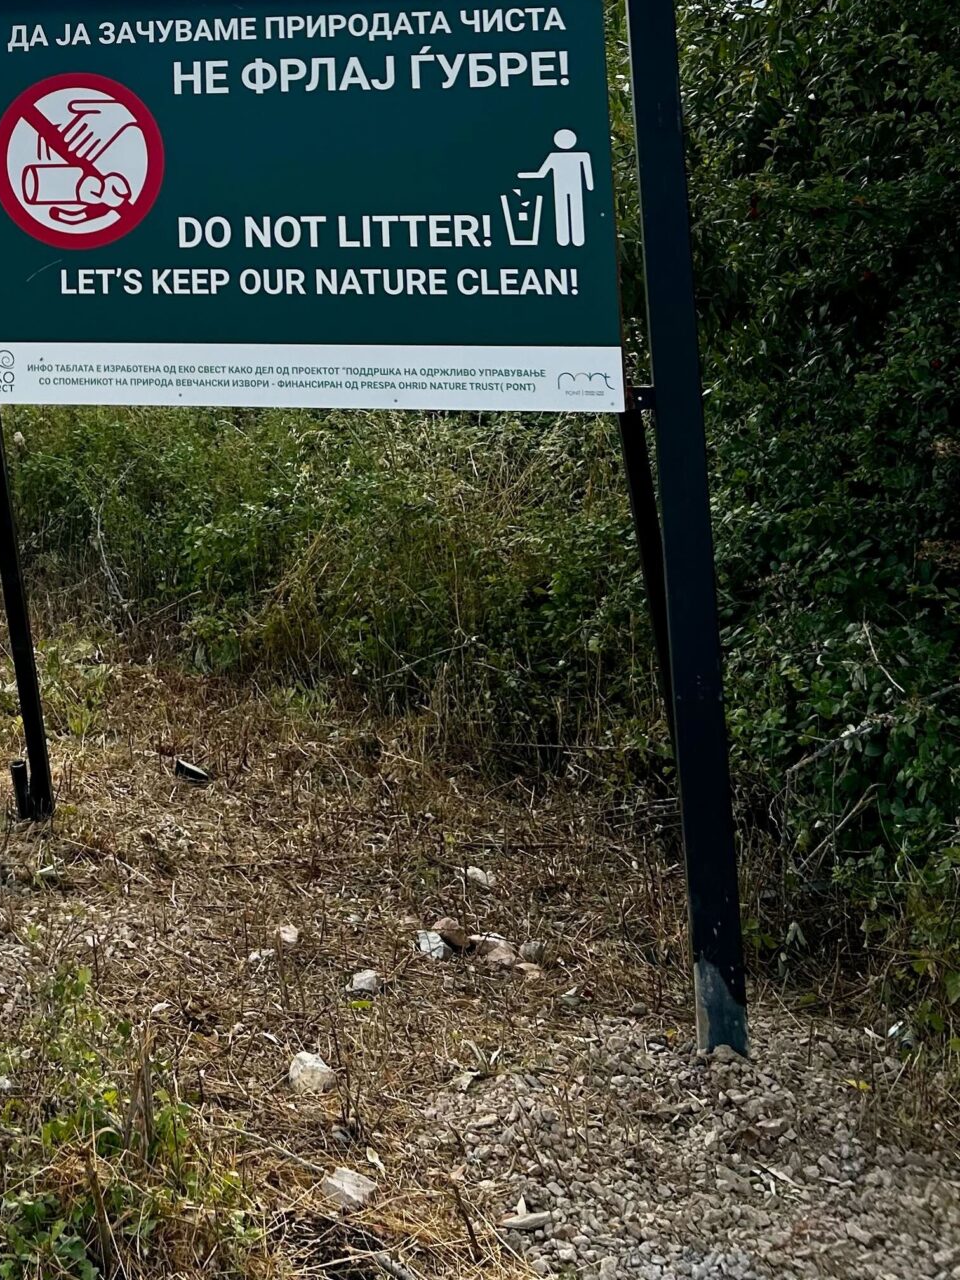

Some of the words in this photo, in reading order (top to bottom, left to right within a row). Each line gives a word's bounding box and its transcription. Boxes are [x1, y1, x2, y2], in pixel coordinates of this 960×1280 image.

[7, 24, 48, 51] ДА
[56, 22, 91, 47] ЈА
[98, 17, 256, 45] ЗАЧУВАМЕ
[265, 11, 451, 42] ПРИРОДАТА
[458, 6, 566, 34] ЧИСТА
[173, 60, 229, 95] НЕ
[241, 54, 395, 94] ФРЛАЈ
[410, 47, 569, 89] ЃУБРЕ!
[178, 216, 231, 249] DO
[245, 216, 327, 249] NOT
[338, 215, 491, 248] LITTER!
[152, 269, 229, 295] KEEP
[240, 269, 305, 296] OUR
[315, 269, 447, 296] NATURE
[456, 269, 578, 297] CLEAN!
[27, 364, 53, 373] ИНФО
[55, 364, 94, 373] ТАБЛАТА
[97, 365, 102, 373] Е
[104, 364, 161, 373] ИЗРАБОТЕНА
[163, 365, 176, 375] ОД
[198, 366, 226, 374] СВЕСТ
[228, 366, 253, 374] КАКО
[255, 366, 273, 375] ДЕЛ
[276, 367, 290, 376] ОД
[292, 367, 340, 375] ПРОЕКТОТ
[420, 368, 476, 377] ОДРЖЛИВО
[479, 368, 546, 377] УПРАВУВАЊЕ
[39, 377, 51, 385] СО
[54, 377, 113, 386] СПОМЕНИКОТ
[116, 378, 128, 386] НА
[130, 378, 173, 387] ПРИРОДА
[176, 379, 230, 387] ВЕВЧАНСКИ
[232, 380, 269, 388] ИЗВОРИ
[277, 380, 342, 389] ФИНАНСИРАН
[345, 381, 358, 390] ОД
[361, 381, 396, 389] PRESPA
[430, 382, 467, 390] NATURE
